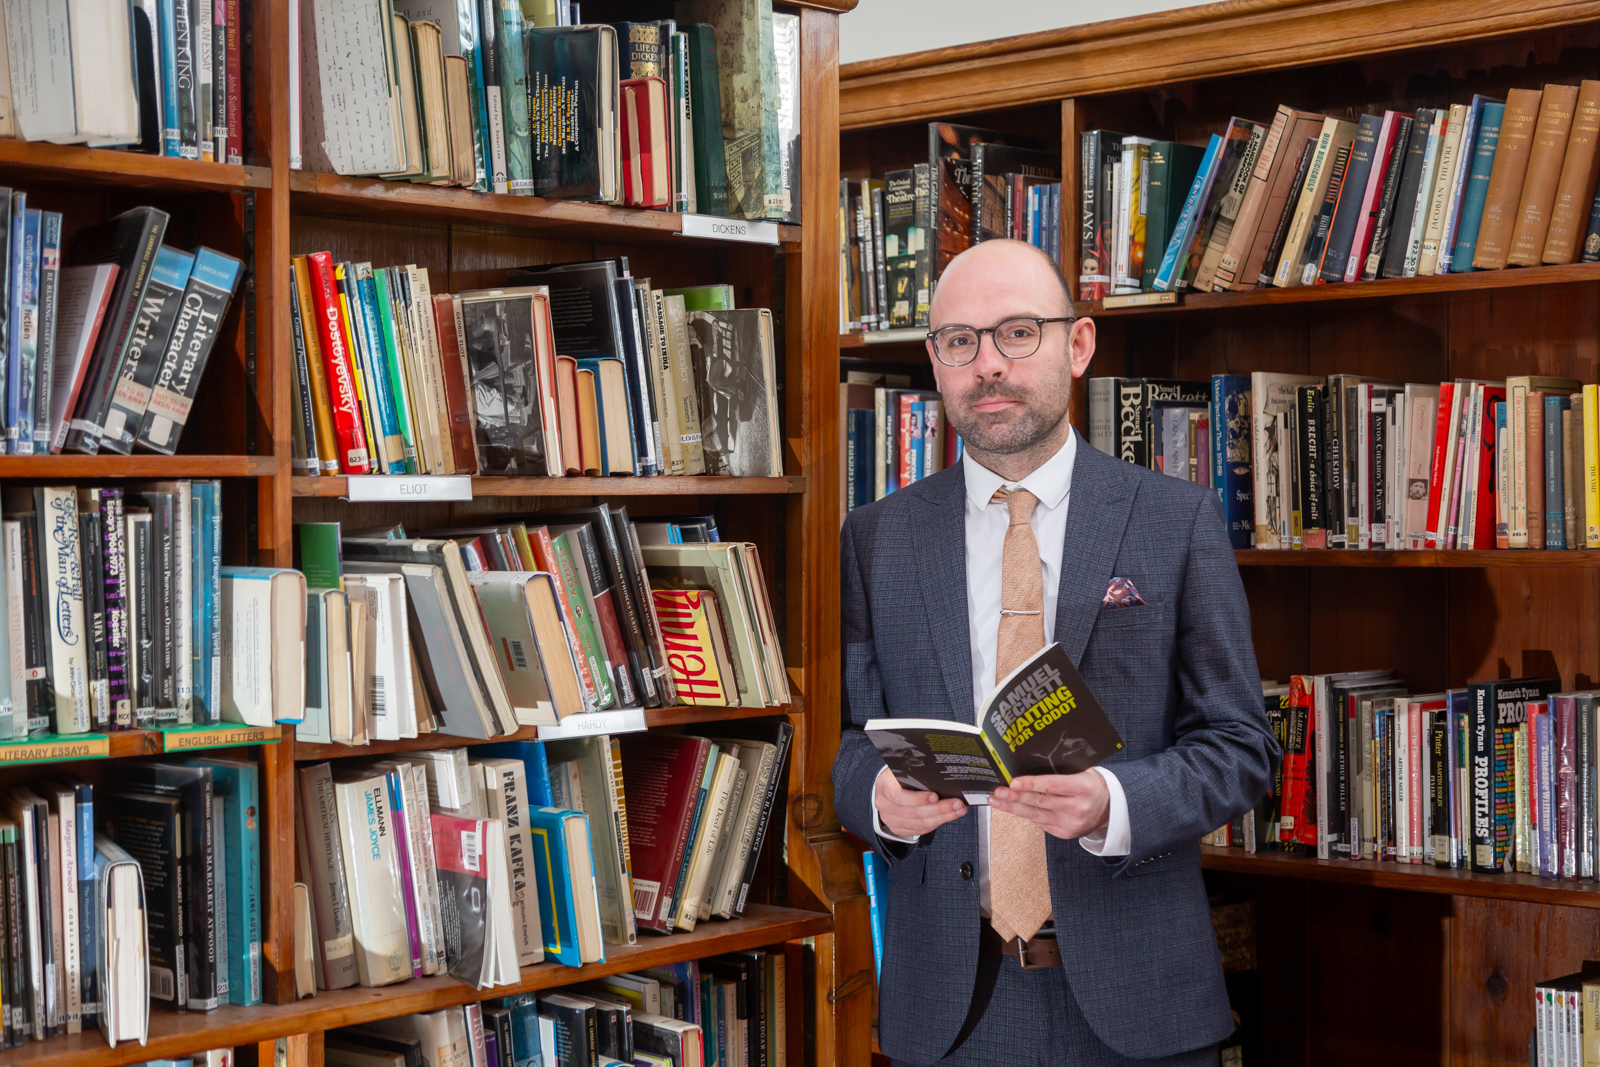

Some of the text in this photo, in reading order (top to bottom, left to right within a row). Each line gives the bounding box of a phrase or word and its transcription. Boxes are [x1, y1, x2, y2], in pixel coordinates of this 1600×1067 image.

[635, 43, 650, 52] LIFE
[228, 74, 238, 137] John Sutherland
[1232, 131, 1256, 194] CONTEMPORARY
[1243, 139, 1260, 184] HANDBOOK
[1306, 132, 1331, 193] DION BOUCICAULT
[1325, 147, 1349, 205] KENNETH BRANAGH
[886, 193, 915, 204] Theatre
[1238, 184, 1245, 195] OF
[1431, 144, 1453, 231] JACOBEAN THEATRE
[712, 223, 747, 236] DICKENS
[930, 204, 938, 230] Round
[1083, 189, 1094, 240] PLAYS
[198, 262, 230, 280] LAROUSSE
[44, 272, 53, 321] RE-READING
[23, 309, 33, 340] fiction
[43, 322, 52, 345] HARRY
[120, 296, 165, 384] Writers
[415, 301, 425, 341] Middlemarch
[455, 311, 463, 337] GEORGE
[656, 302, 666, 336] PASSAGE
[661, 337, 667, 346] TO
[42, 346, 51, 372] POTTER
[178, 308, 218, 397] Literary
[326, 307, 353, 414] Dostoyevsky
[155, 392, 188, 410] NOT TO BE
[1159, 384, 1176, 394] Samuel
[1214, 379, 1222, 403] Victorian
[1306, 389, 1315, 413] Esslin
[682, 396, 690, 424] Summers
[1135, 404, 1143, 442] Samuel
[1515, 406, 1523, 430] Classical
[1307, 418, 1317, 459] BRECHT
[1515, 430, 1523, 453] Moment
[1309, 469, 1317, 492] choice
[1515, 459, 1523, 480] Martin
[399, 483, 428, 495] ELIOT
[1309, 493, 1318, 502] of
[1310, 502, 1318, 520] evils
[106, 500, 119, 576] Essays 1968-1973
[163, 541, 171, 570] MODEST
[163, 570, 171, 605] PROPOSAL
[211, 515, 221, 655] Hermione Granger Saves the World
[558, 547, 578, 597] HARDY
[566, 553, 579, 587] THOMAS
[164, 617, 172, 641] OTHER
[581, 623, 592, 652] CLAIRE
[164, 641, 172, 669] SATIRES
[990, 663, 1060, 728] SAMUEL
[995, 671, 1064, 738] BECKETT
[1497, 687, 1540, 700] Kenneth Tynan
[577, 719, 608, 731] HARDY
[1001, 685, 1073, 745] WAITING
[1008, 727, 1035, 753] FOR
[1033, 697, 1078, 732] GODOT
[1294, 711, 1305, 750] MARLOWE
[0, 745, 90, 761] ITERARY ESSAYS
[178, 731, 265, 747] ENGLISH: LETTERS
[1434, 730, 1443, 756] Pinter
[760, 744, 778, 780] SONS
[1474, 688, 1489, 838] Kenneth Tynan PROFILES
[323, 776, 337, 824] JOHNSON
[1540, 744, 1550, 832] Tennessee Williams
[316, 778, 335, 872] THE CRITICAL HERITAGE
[364, 790, 381, 860] JAMES JOYCE
[373, 787, 386, 837] ELLMANN
[502, 770, 526, 892] FRANZ KAFKA
[704, 789, 730, 856] The Deed of Life
[752, 790, 774, 852] D. H. LAWRENCE
[738, 809, 760, 861] LOVERS
[64, 819, 75, 894] Margaret Atwood
[206, 855, 215, 963] MARGARET ATWOOD
[518, 899, 530, 946] Wilhelm Emrich
[473, 1018, 484, 1050] IRIS
